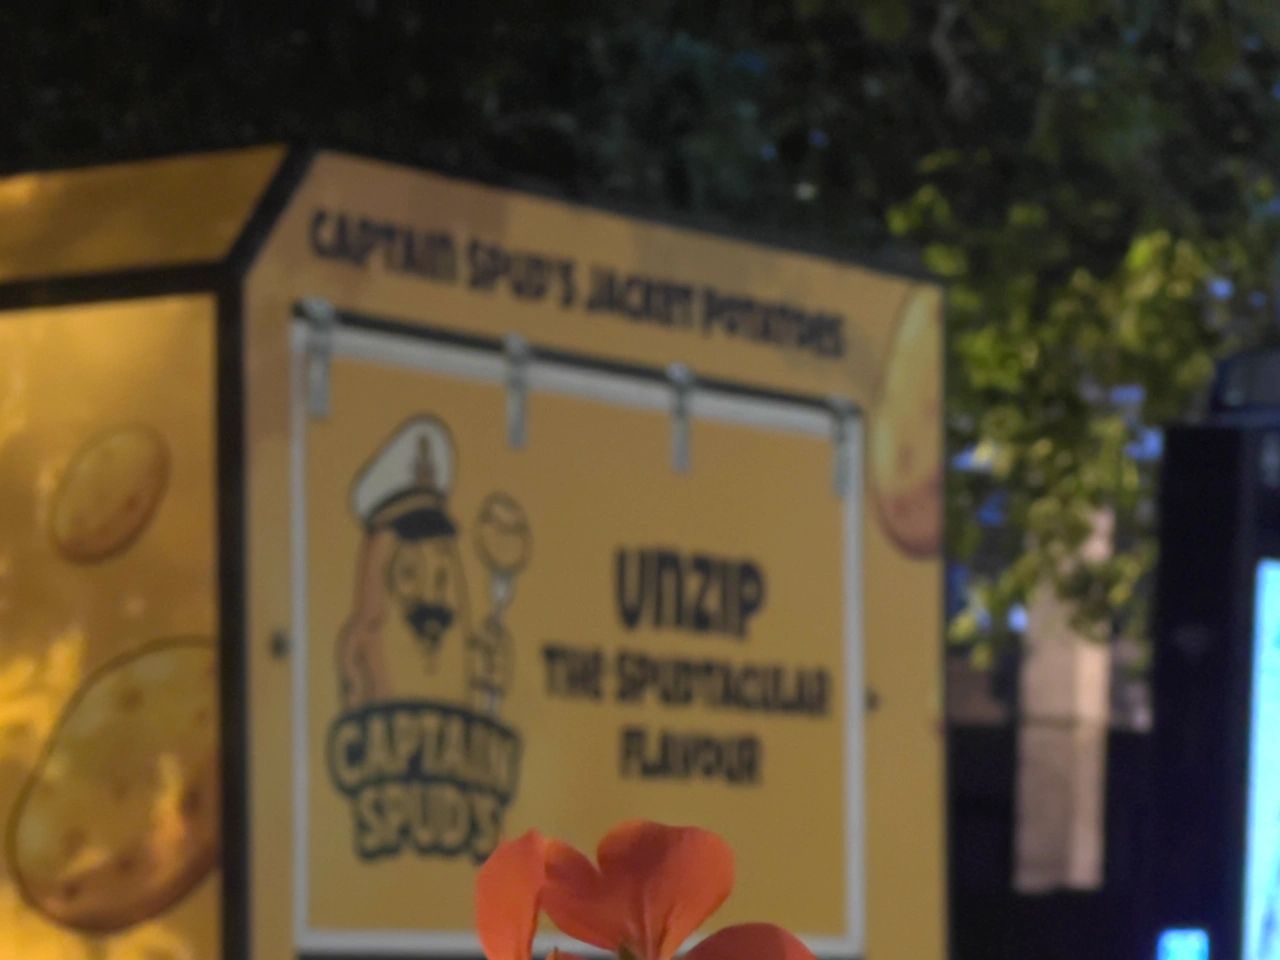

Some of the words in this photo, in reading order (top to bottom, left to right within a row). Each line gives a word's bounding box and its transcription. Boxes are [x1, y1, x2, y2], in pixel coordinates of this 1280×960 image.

[309, 209, 457, 283] CAPTAIN
[614, 546, 766, 640] UNZIP
[541, 642, 604, 700] THE
[330, 706, 518, 793] CAPTAIN
[620, 725, 763, 786] FLAVOUR
